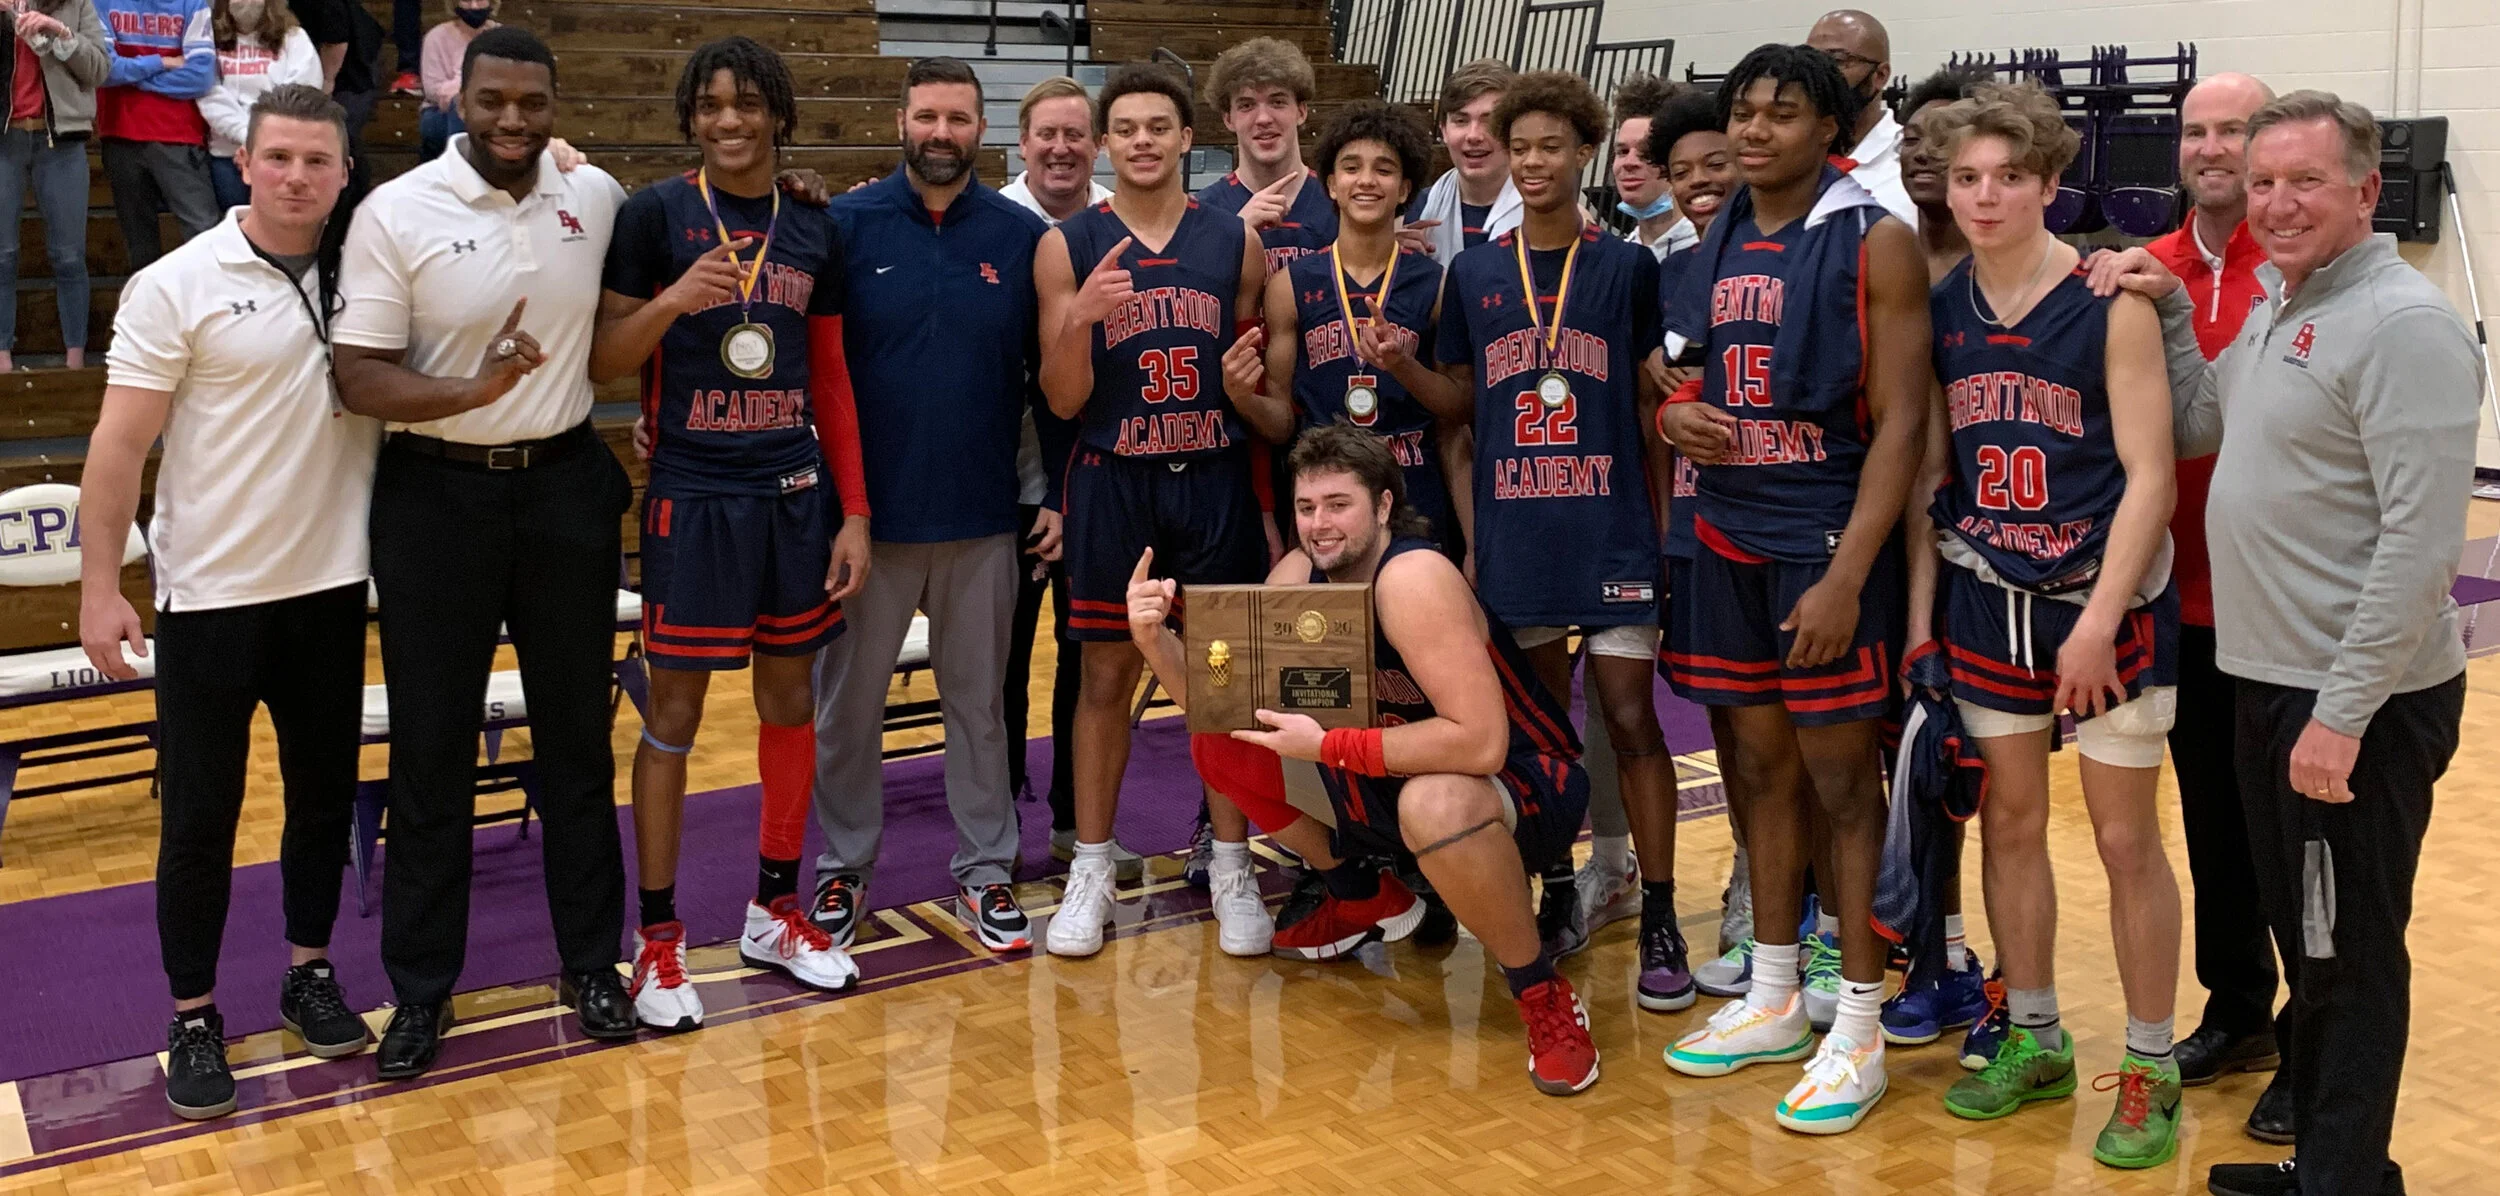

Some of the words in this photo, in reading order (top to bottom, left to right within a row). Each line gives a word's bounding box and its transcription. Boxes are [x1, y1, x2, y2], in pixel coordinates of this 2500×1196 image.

[109, 11, 183, 36] OILERS
[1104, 286, 1221, 350] BRENTWOOD
[1138, 345, 1200, 404] 35
[1722, 344, 1773, 407] 15
[686, 389, 804, 432] ACADEMY
[1113, 410, 1230, 455] ACADEMY
[1515, 390, 1578, 446] 22
[1947, 371, 2084, 438] BRENTWOOD
[1495, 455, 1613, 500] ACADEMY
[1977, 444, 2049, 511] 20
